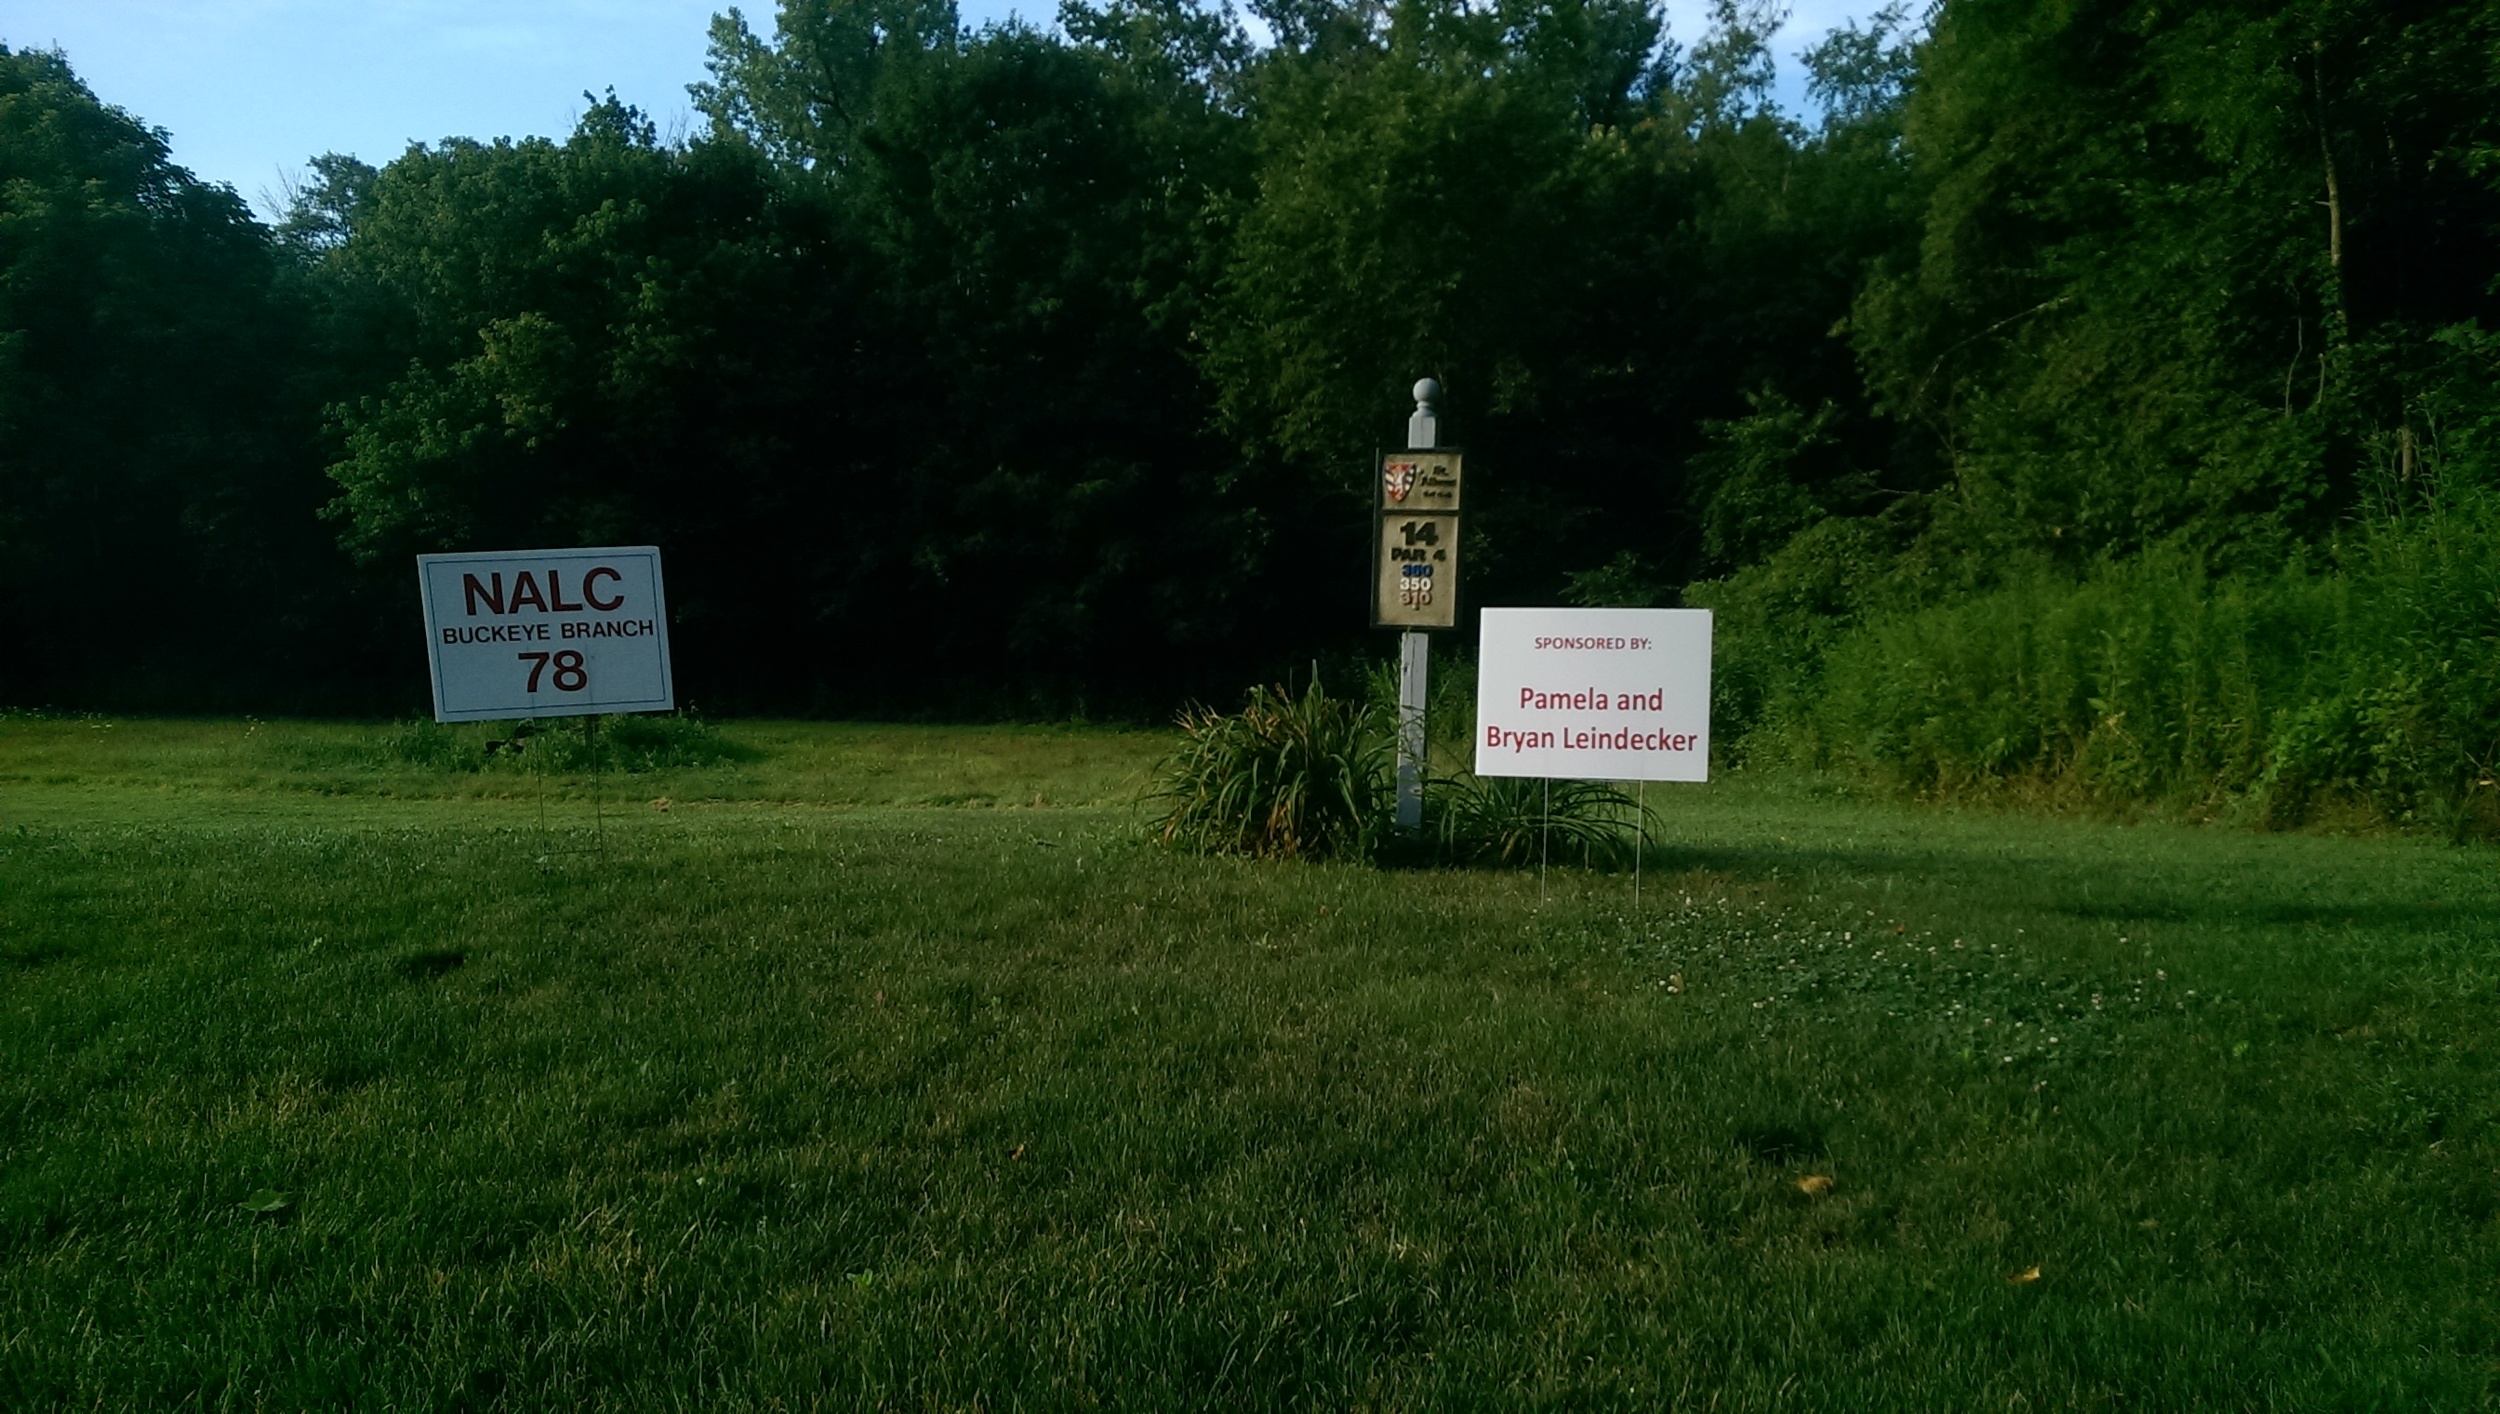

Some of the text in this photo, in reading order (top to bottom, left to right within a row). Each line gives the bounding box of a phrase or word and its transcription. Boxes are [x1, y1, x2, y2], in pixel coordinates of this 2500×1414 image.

[1400, 522, 1439, 546] 14
[1391, 548, 1447, 561] PAR 4
[463, 567, 625, 616] NALC
[1400, 577, 1432, 591] 350
[1400, 592, 1433, 605] 310
[442, 619, 654, 645] BUCKEYE BRANCH
[1534, 637, 1652, 650] SPONSORED BY:
[518, 650, 588, 693] 78
[1520, 687, 1663, 711] Pamela and
[1487, 726, 1698, 753] Bryan Leindecker
